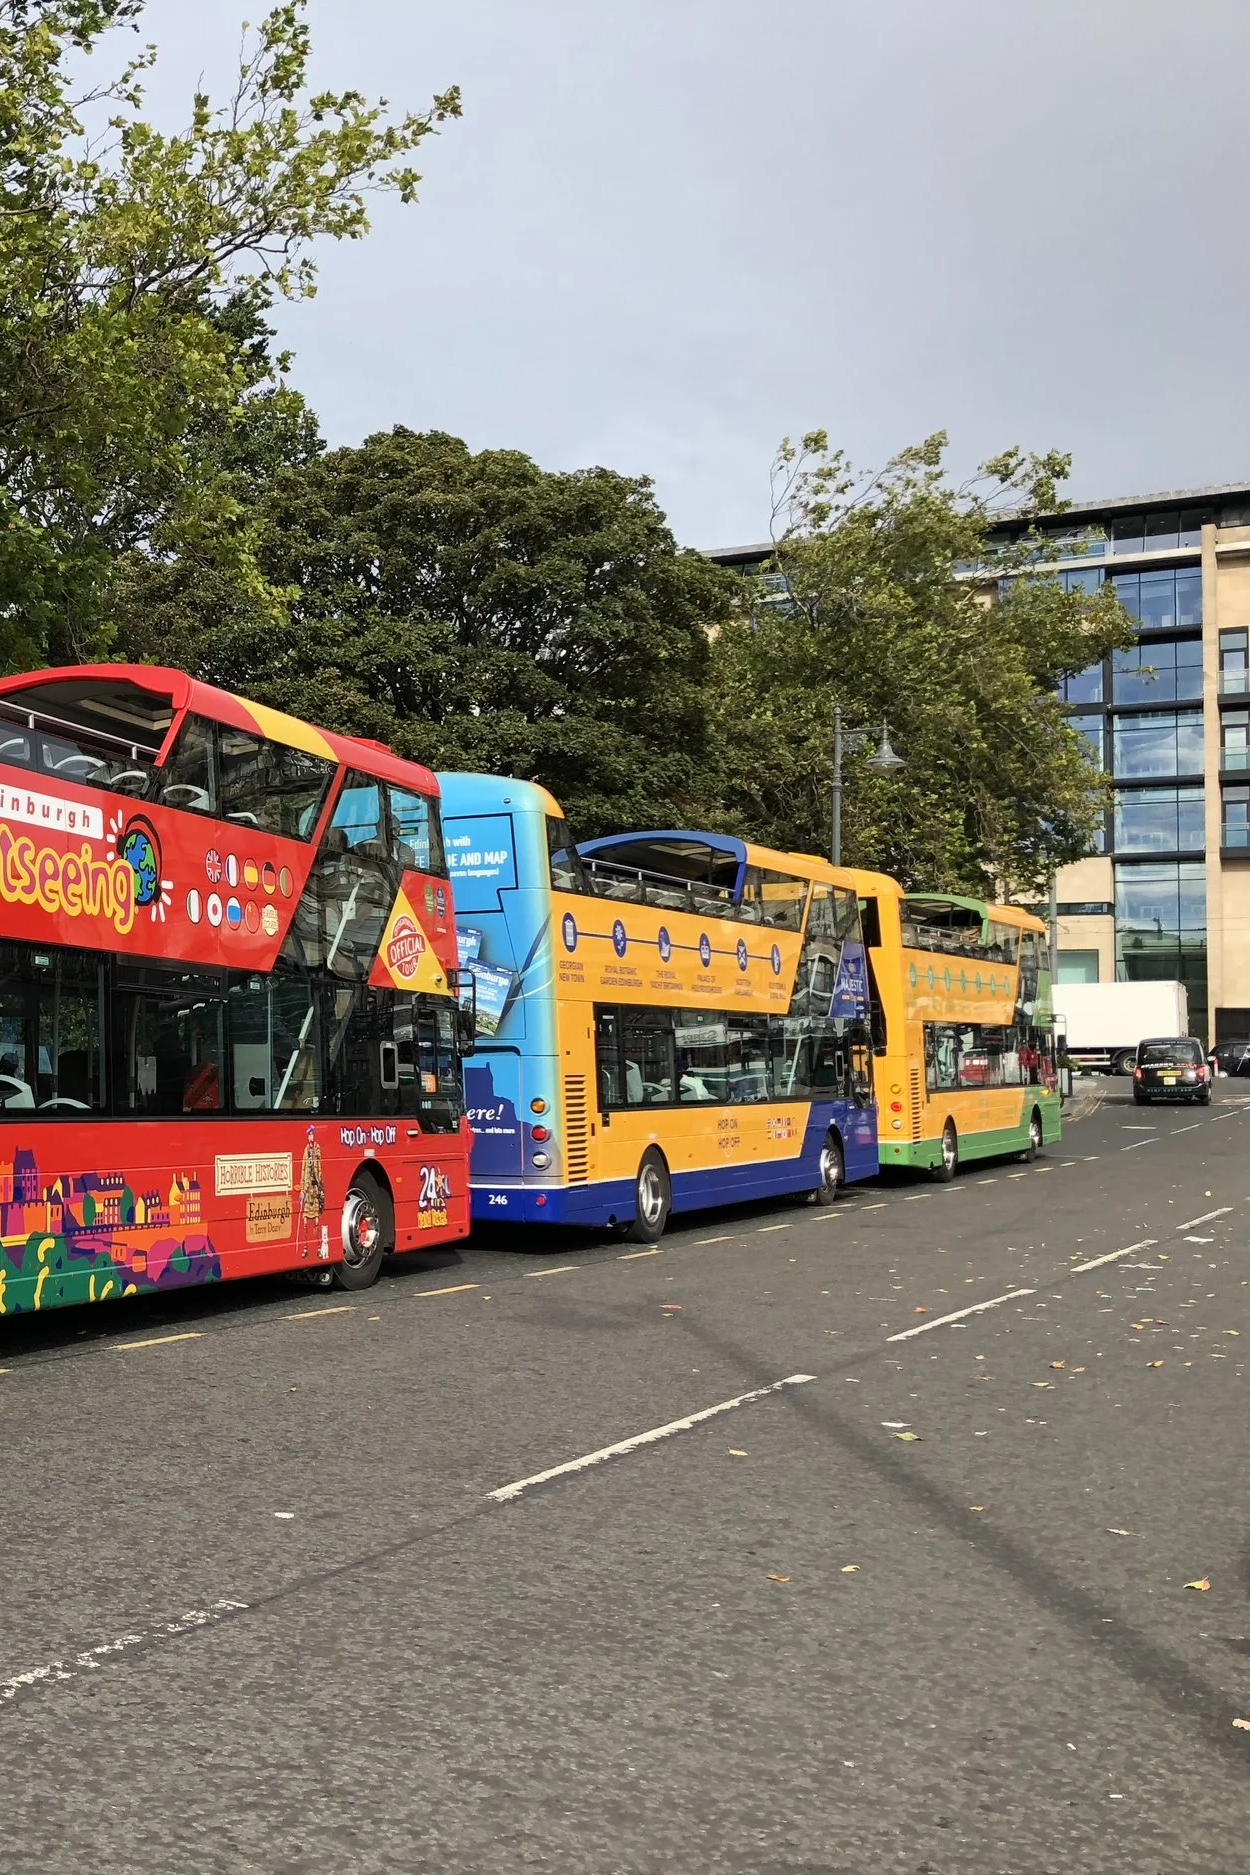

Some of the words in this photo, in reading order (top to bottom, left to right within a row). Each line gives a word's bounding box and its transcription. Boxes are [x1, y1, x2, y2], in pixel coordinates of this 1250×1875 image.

[452, 835, 471, 847] with
[460, 852, 481, 867] AND
[484, 850, 507, 865] MAP
[390, 936, 425, 962] OFFICIAL
[401, 957, 418, 975] TOUR
[467, 1104, 504, 1121] ere!
[340, 1127, 355, 1147] Hop
[356, 1126, 366, 1145] On
[370, 1126, 384, 1146] Hop
[385, 1125, 397, 1143] Off
[418, 1167, 437, 1208] 24
[488, 1194, 508, 1205] 246
[248, 1201, 290, 1224] Edinburgh
